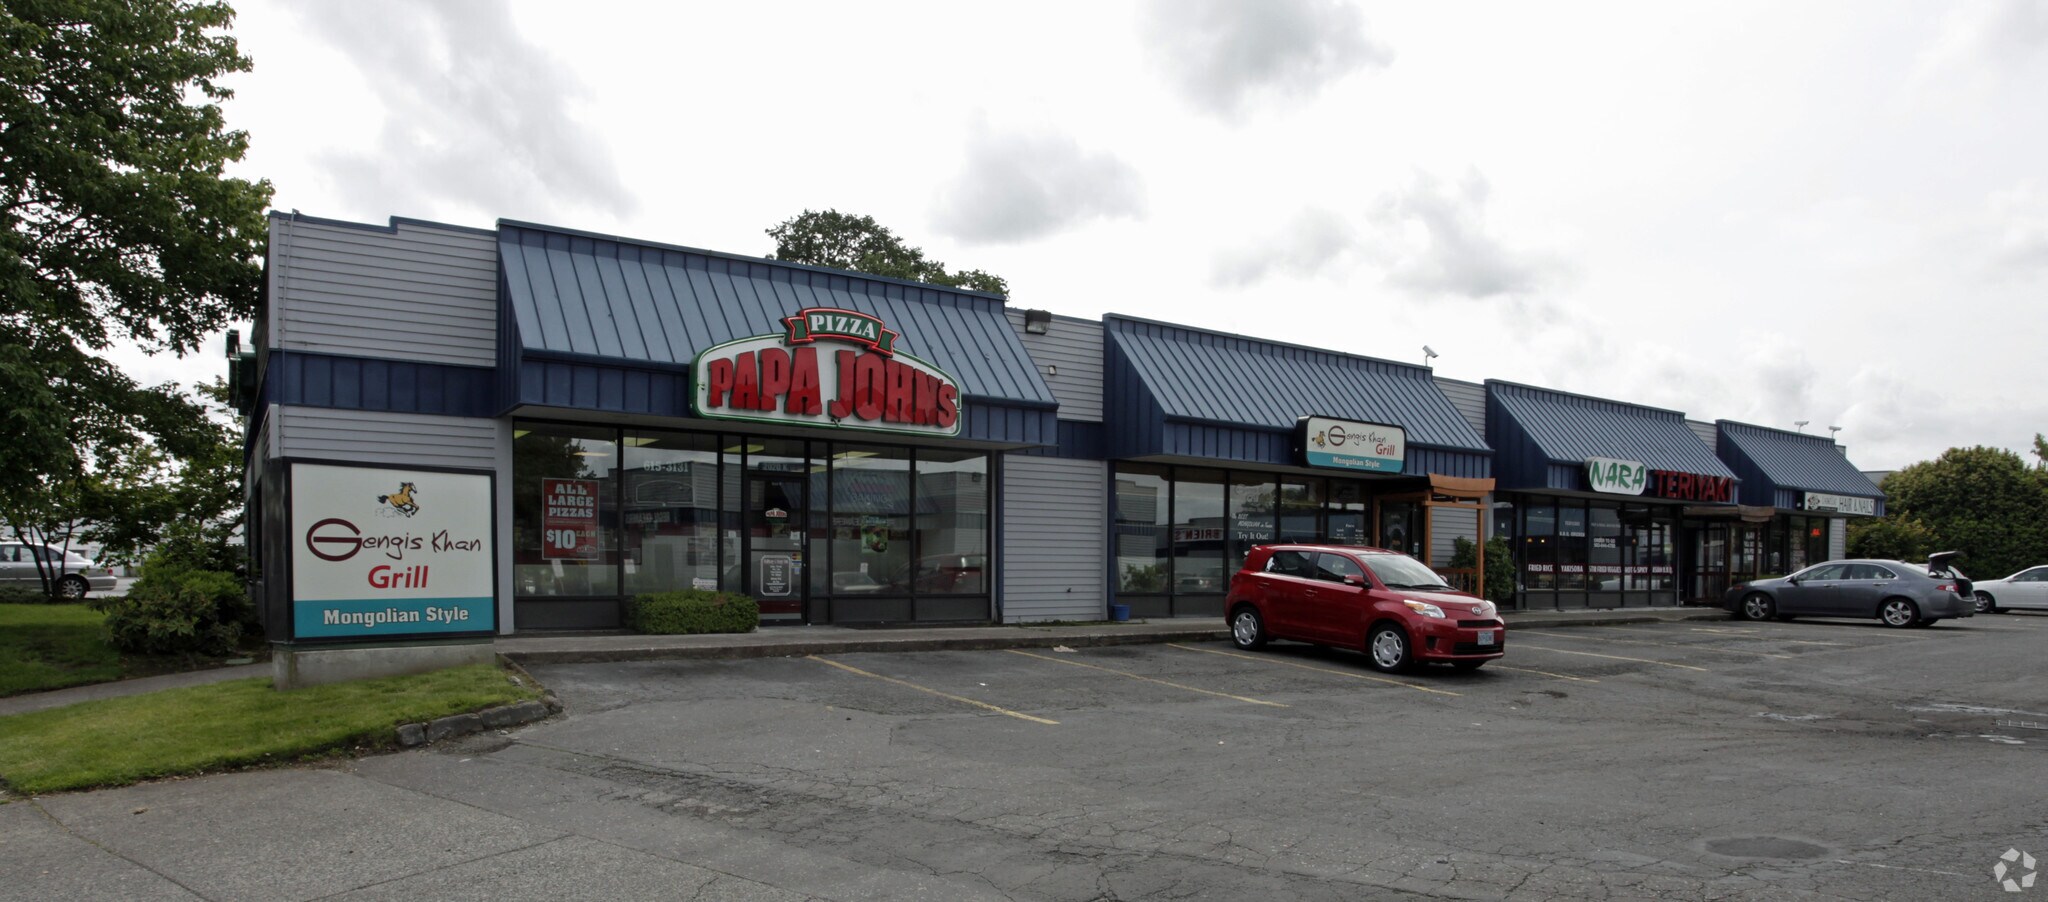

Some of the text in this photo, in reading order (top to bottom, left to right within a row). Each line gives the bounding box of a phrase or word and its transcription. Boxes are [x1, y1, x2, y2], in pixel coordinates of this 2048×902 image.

[809, 314, 876, 340] PIZZA
[707, 347, 957, 428] PAPA JOHN'S
[1328, 425, 1387, 447] Gengis Khan
[1375, 443, 1396, 456] Grill
[643, 460, 689, 473] 615-3131
[1332, 456, 1381, 468] Mongolian Style
[1590, 460, 1734, 502] NARA TERIYAKI
[555, 483, 587, 495] ALL
[548, 495, 594, 507] LARGE
[548, 507, 594, 518] PIZZAS
[306, 518, 481, 562] Gengis Khan
[546, 529, 576, 549] $10
[1237, 532, 1269, 542] Try It Out!
[1528, 564, 1542, 572] FRIED
[1561, 565, 1584, 573] YAKISOBA
[368, 565, 429, 589] Grill
[323, 606, 469, 627] Mongolian Style
